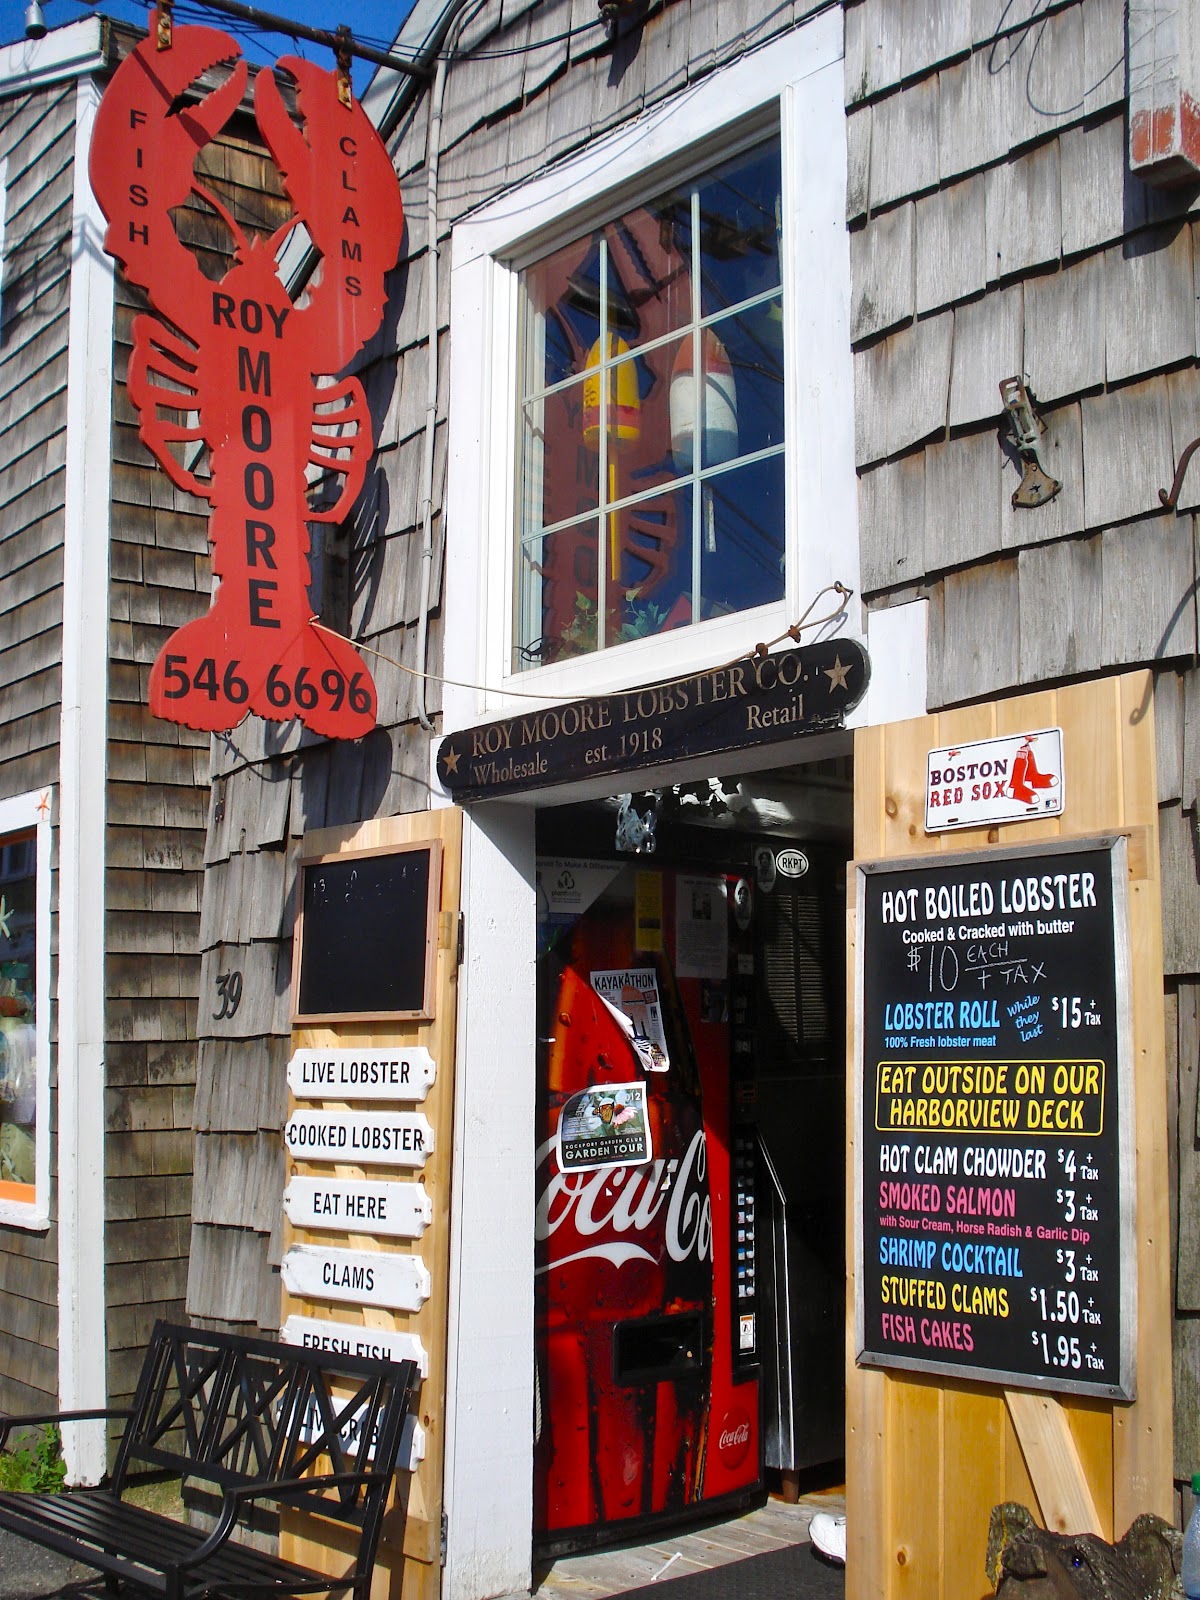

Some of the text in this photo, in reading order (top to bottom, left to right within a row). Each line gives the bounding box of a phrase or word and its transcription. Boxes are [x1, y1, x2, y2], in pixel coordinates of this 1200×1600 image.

[128, 109, 149, 246] FISH
[339, 136, 363, 297] CLAMS
[211, 291, 290, 340] ROY
[237, 345, 281, 629] MOORE
[163, 654, 373, 715] 546 6696
[472, 653, 809, 758] ROY MOORE LOBSTER CO.
[474, 695, 805, 787] Wholesale est. 1918 Retail
[929, 758, 1009, 787] BOSTON
[929, 779, 1009, 808] RED SOX
[783, 857, 802, 870] RKPT
[881, 871, 1097, 923] HOT BOILED LOBSTER
[902, 919, 1075, 944] Cooked & Cracked with butter
[594, 972, 654, 991] KAYAKATHON
[1000, 961, 1048, 985] TAX
[212, 969, 243, 1021] 39
[1006, 994, 1041, 1018] While
[884, 1000, 1000, 1030] LOBSTER ROLL
[1015, 1010, 1040, 1029] they
[1052, 996, 1081, 1029] $15
[1084, 1011, 1101, 1026] Tax
[884, 1034, 997, 1048] 100% Fresh lobster meat
[1020, 1024, 1043, 1043] last
[302, 1061, 411, 1084] LIVE LOBSTER
[880, 1065, 1099, 1095] EAT OUTSIDE ON OUR
[889, 1098, 1085, 1130] HARBORVIEW DECK
[289, 1124, 423, 1151] COOKED LOBSTER
[565, 1146, 610, 1160] GARDEN
[614, 1143, 644, 1154] TOUR
[879, 1145, 1047, 1180] HOT CLAM CHOWDER
[1057, 1148, 1077, 1182] $4
[1080, 1165, 1099, 1181] Tax
[313, 1191, 387, 1220] EAT HERE
[879, 1181, 1016, 1218] SMOKED SALMON
[1056, 1189, 1076, 1223] $3
[1079, 1205, 1099, 1221] Tax
[879, 1215, 1090, 1245] with Sour Cream, Horse Radish & Garlic Dip
[879, 1237, 1024, 1278] SHRIMP COCKTAIL
[1056, 1249, 1076, 1283] $3
[322, 1262, 375, 1292] CLAMS
[1079, 1266, 1099, 1282] Tax
[881, 1275, 1010, 1319] STUFFED CLAMS
[1030, 1286, 1080, 1324] $1.50
[881, 1312, 975, 1352] FISH CAKES
[1082, 1309, 1101, 1326] Tax
[1031, 1330, 1082, 1370] $1.95
[1085, 1354, 1105, 1371] Tax
